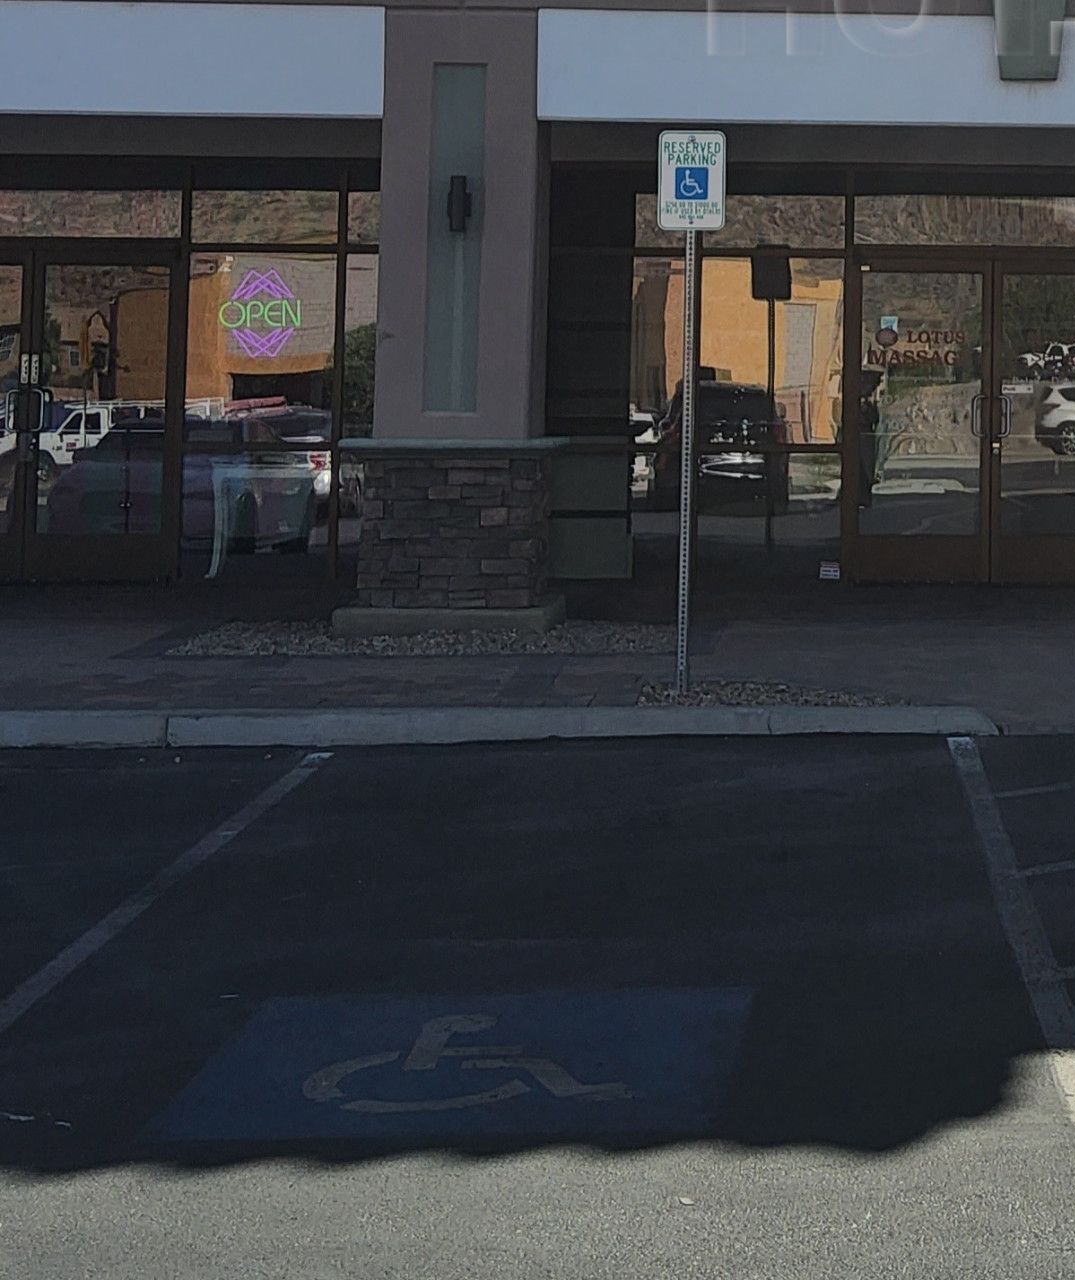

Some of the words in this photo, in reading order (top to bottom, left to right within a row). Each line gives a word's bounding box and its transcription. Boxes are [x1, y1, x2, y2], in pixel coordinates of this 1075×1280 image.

[663, 141, 721, 154] RESERVED
[667, 153, 717, 166] PARKING
[219, 299, 301, 328] OPEN
[906, 329, 965, 345] LOTUS
[866, 348, 970, 367] MASSAG
